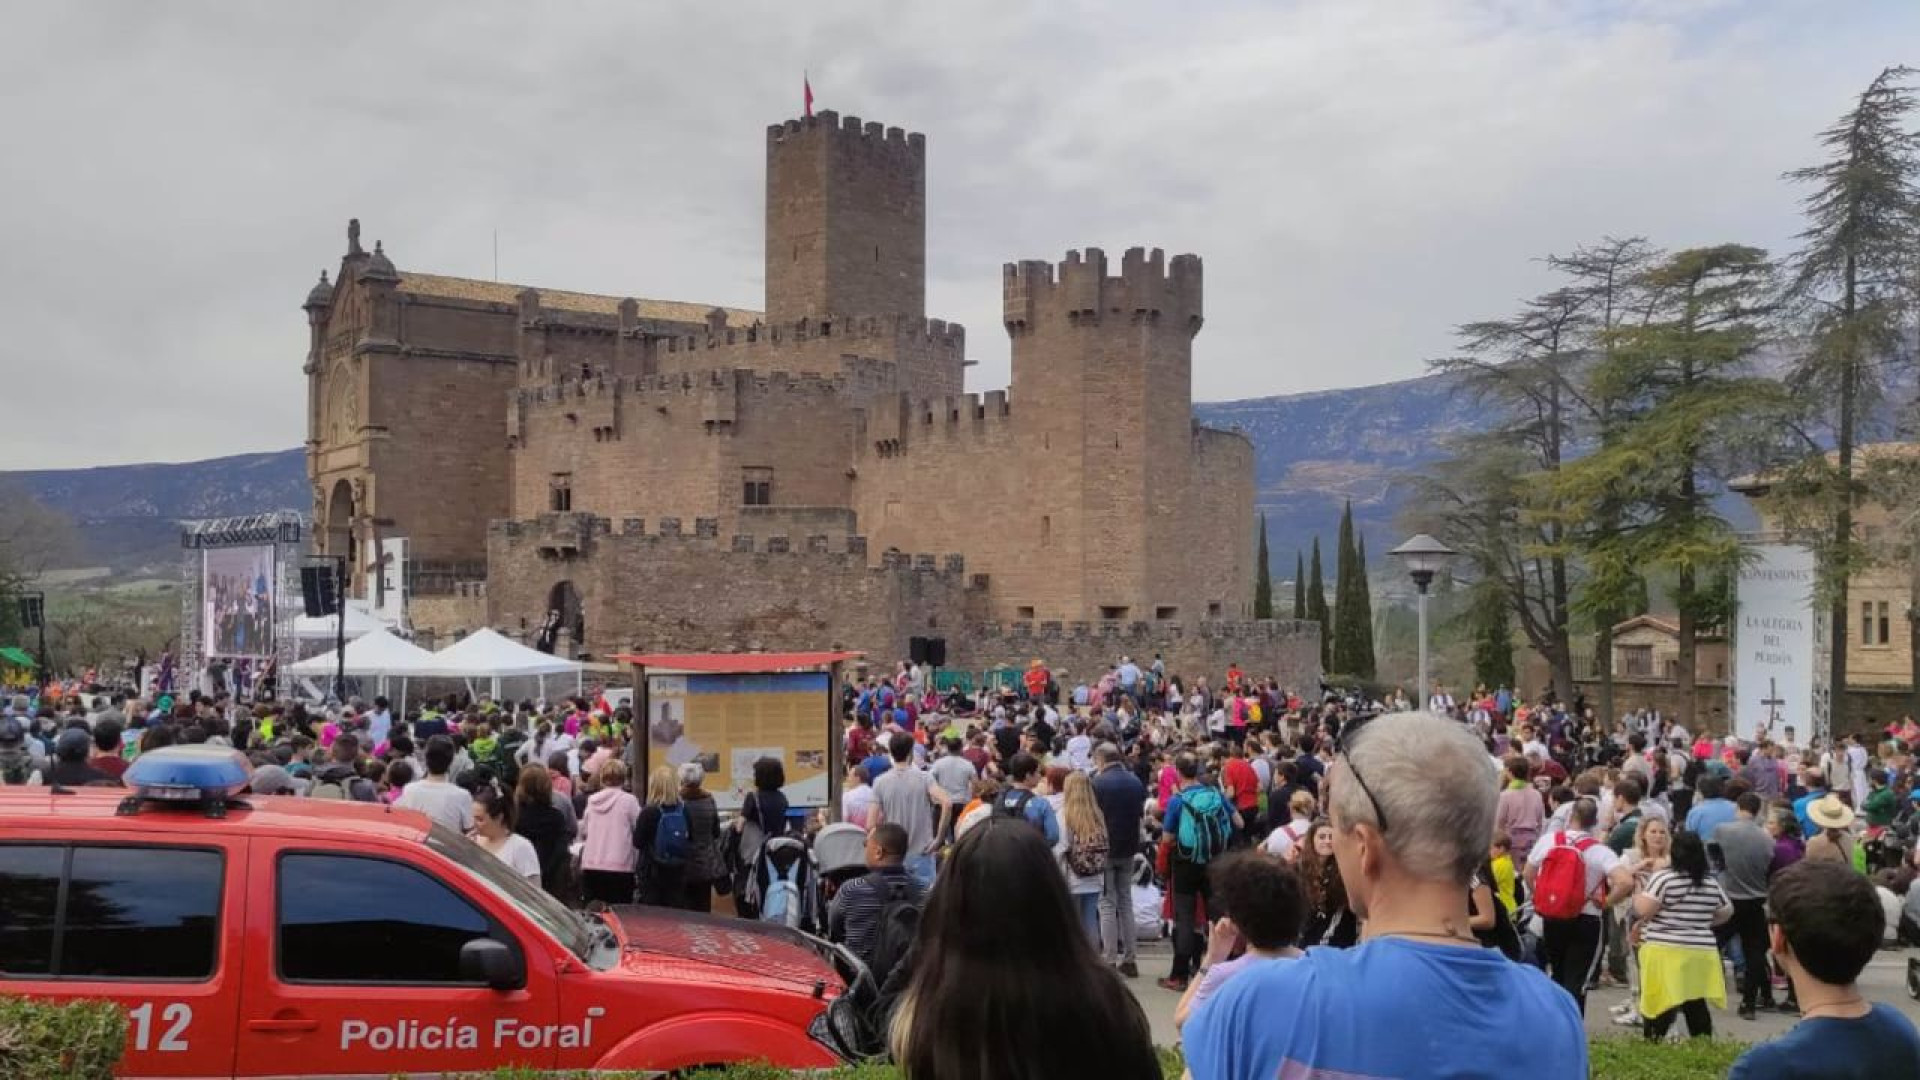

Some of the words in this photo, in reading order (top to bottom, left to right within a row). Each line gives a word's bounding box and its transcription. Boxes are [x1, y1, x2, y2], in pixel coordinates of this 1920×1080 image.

[1746, 616, 1760, 627] LA
[1763, 634, 1780, 647] DEL
[340, 1016, 478, 1050] Policía
[494, 1016, 592, 1048] Foral
